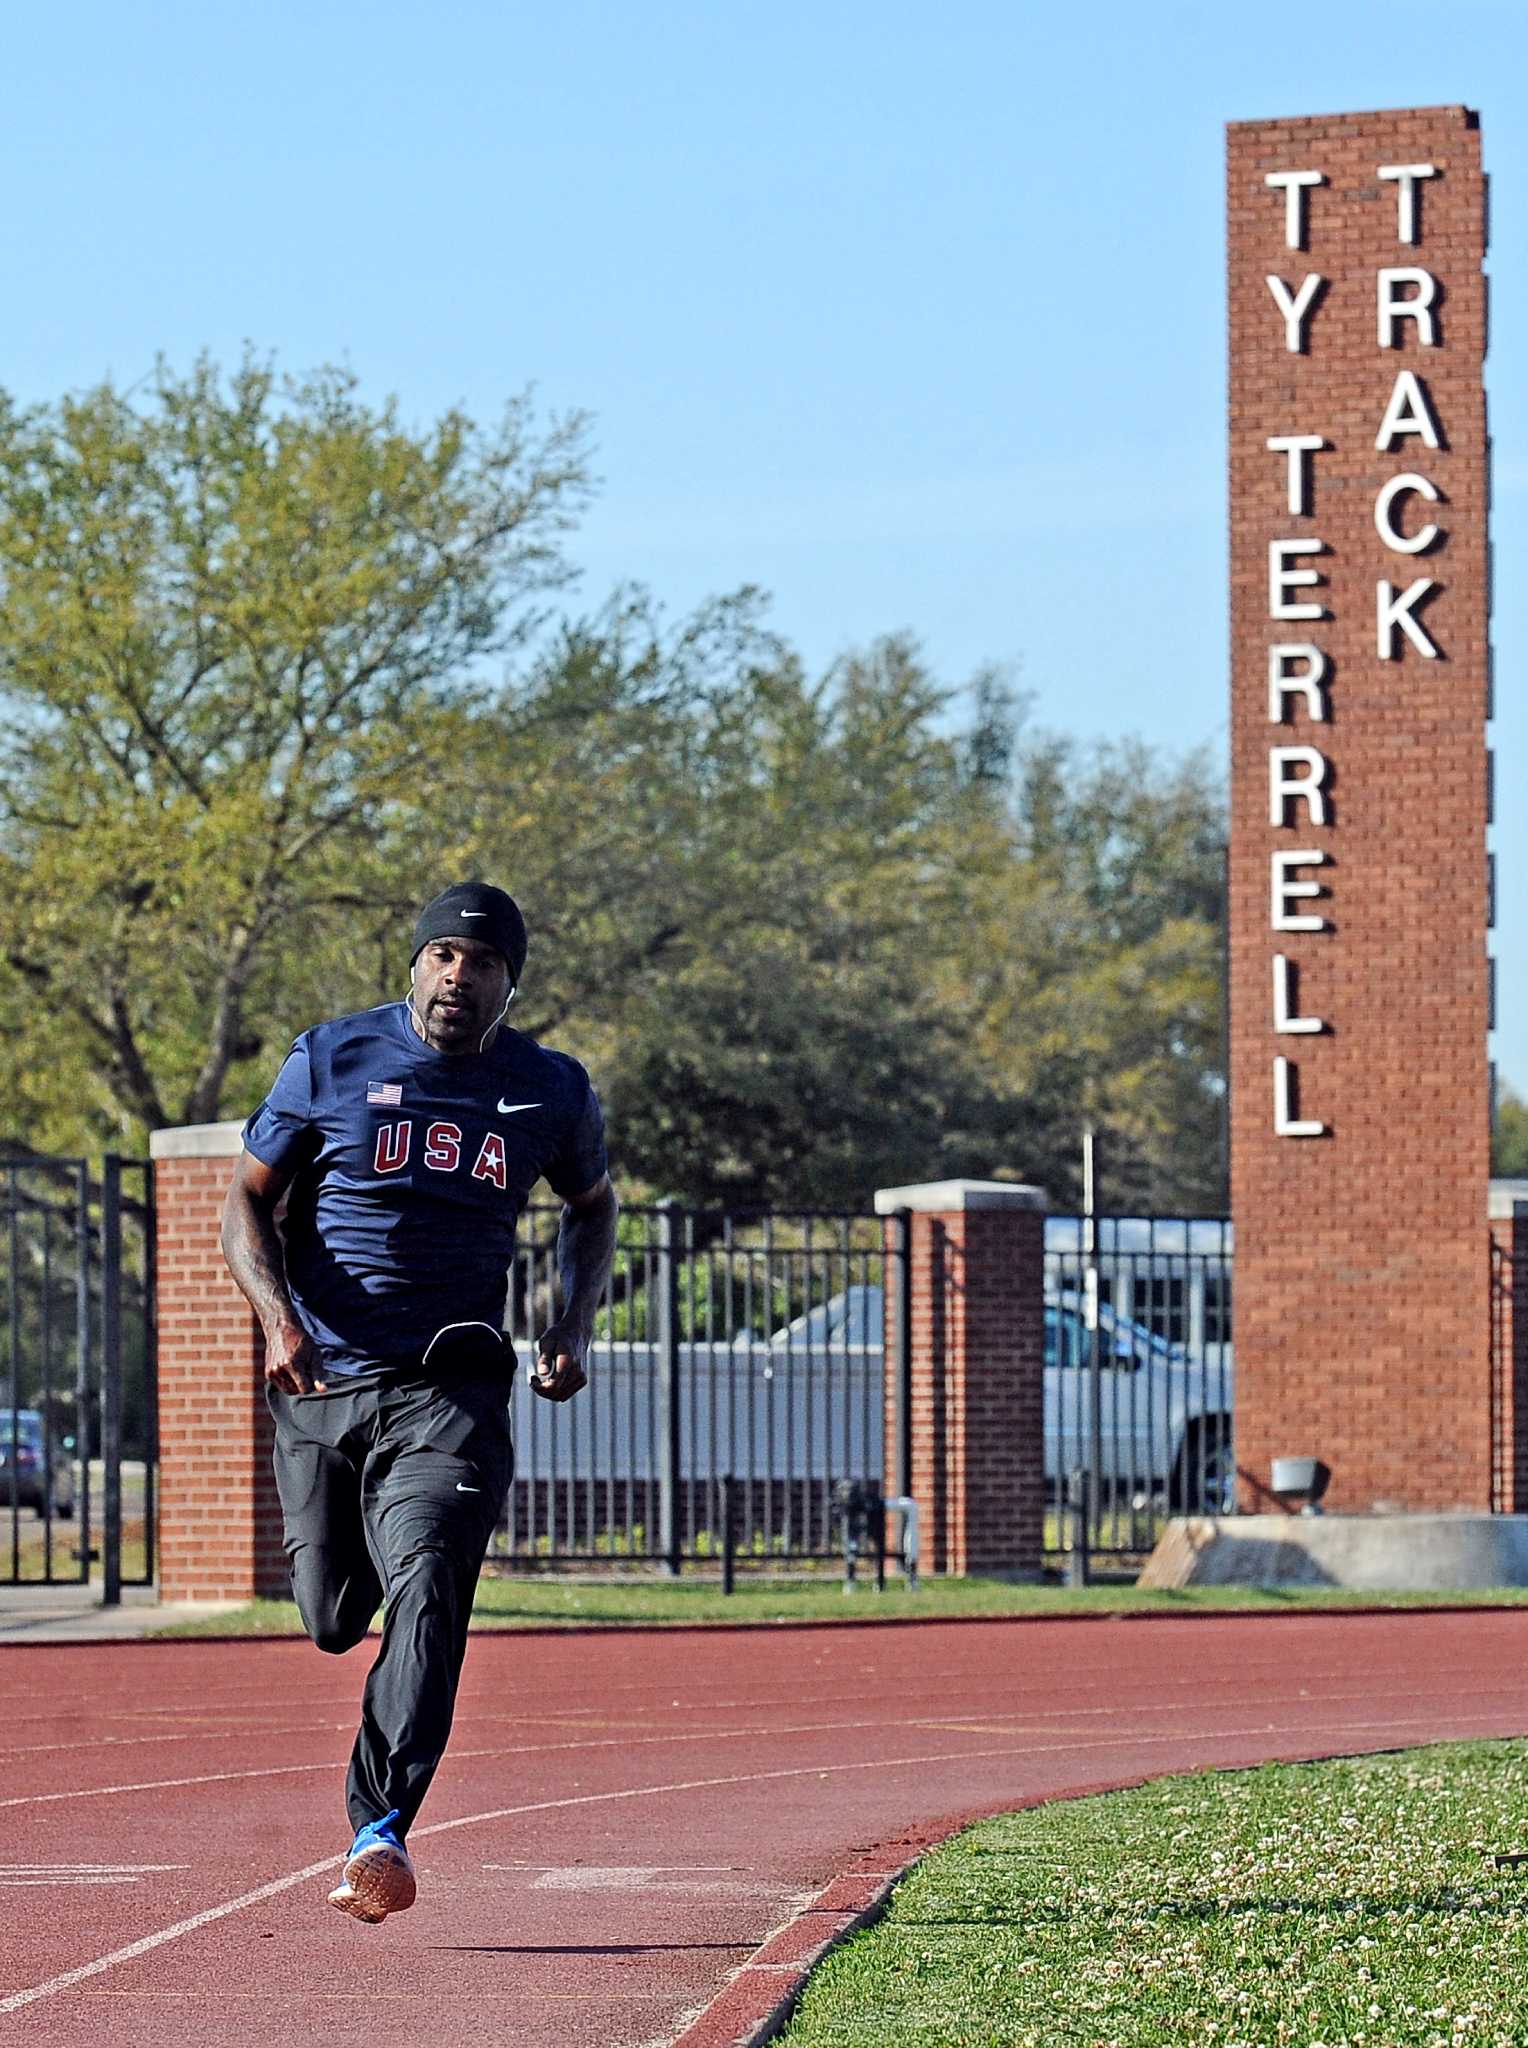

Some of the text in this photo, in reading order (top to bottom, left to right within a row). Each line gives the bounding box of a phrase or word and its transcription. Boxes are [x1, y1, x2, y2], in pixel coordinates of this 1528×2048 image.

[1265, 171, 1328, 1136] TY TERRELL
[1375, 163, 1440, 660] TRACK
[374, 1120, 507, 1190] USA
